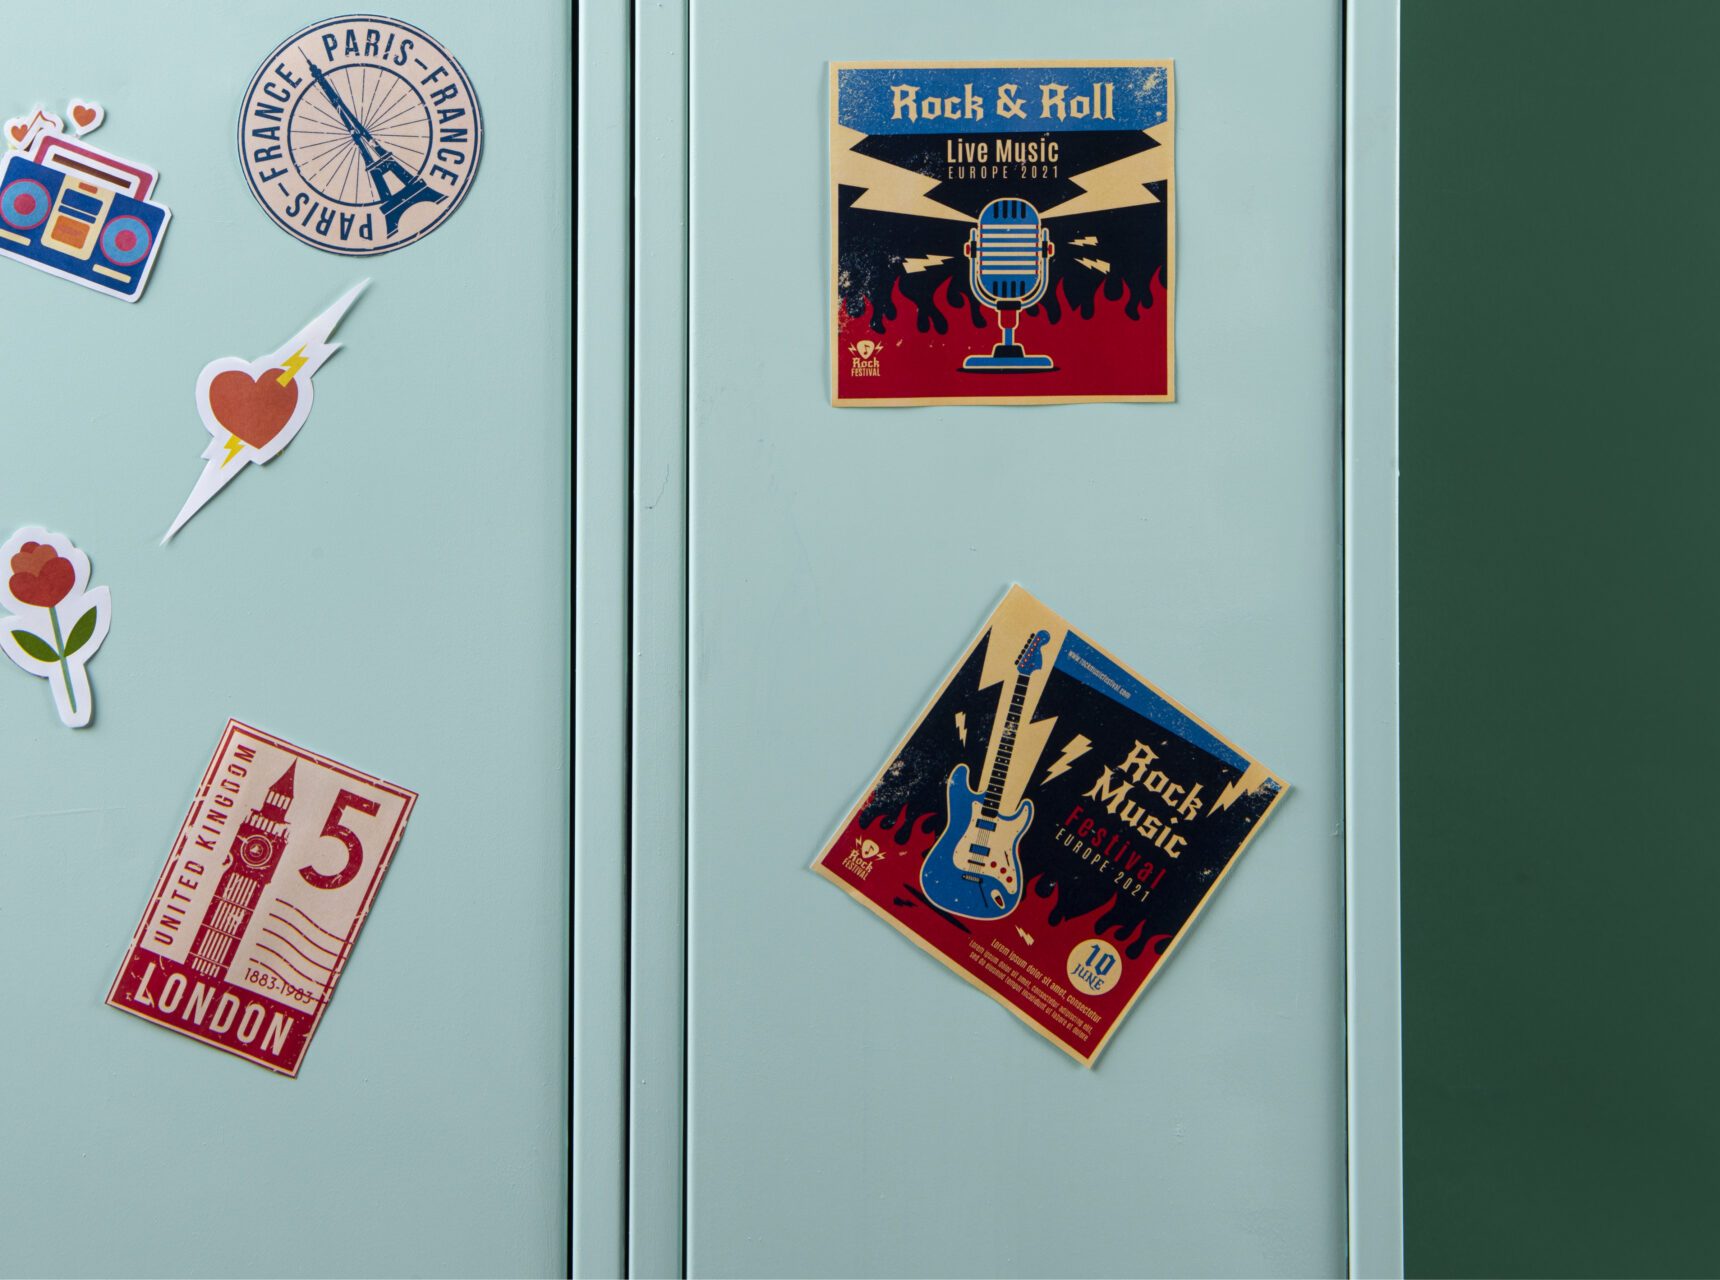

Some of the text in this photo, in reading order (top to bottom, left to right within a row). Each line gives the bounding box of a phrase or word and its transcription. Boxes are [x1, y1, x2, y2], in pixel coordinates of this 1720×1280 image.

[890, 82, 1115, 123] Rock & Roll
[947, 138, 1059, 163] Live Music
[948, 165, 1059, 180] EUROPE 2021
[851, 357, 880, 369] Rock
[851, 367, 881, 377] FESTIVAL
[1117, 739, 1204, 821] Rock
[1081, 764, 1188, 859] Music
[154, 744, 257, 946] UNITED KINGDOM
[298, 788, 381, 890] 5
[1065, 805, 1167, 890] Festival
[842, 857, 869, 881] FESTIVAL
[848, 849, 873, 873] Rock
[1055, 828, 1150, 902] EUROPE 2021
[990, 938, 1010, 956] Lorem
[1041, 976, 1052, 987] sit
[1070, 963, 1104, 991] JUNE
[1085, 944, 1116, 976] 10
[133, 962, 295, 1056] LONDON
